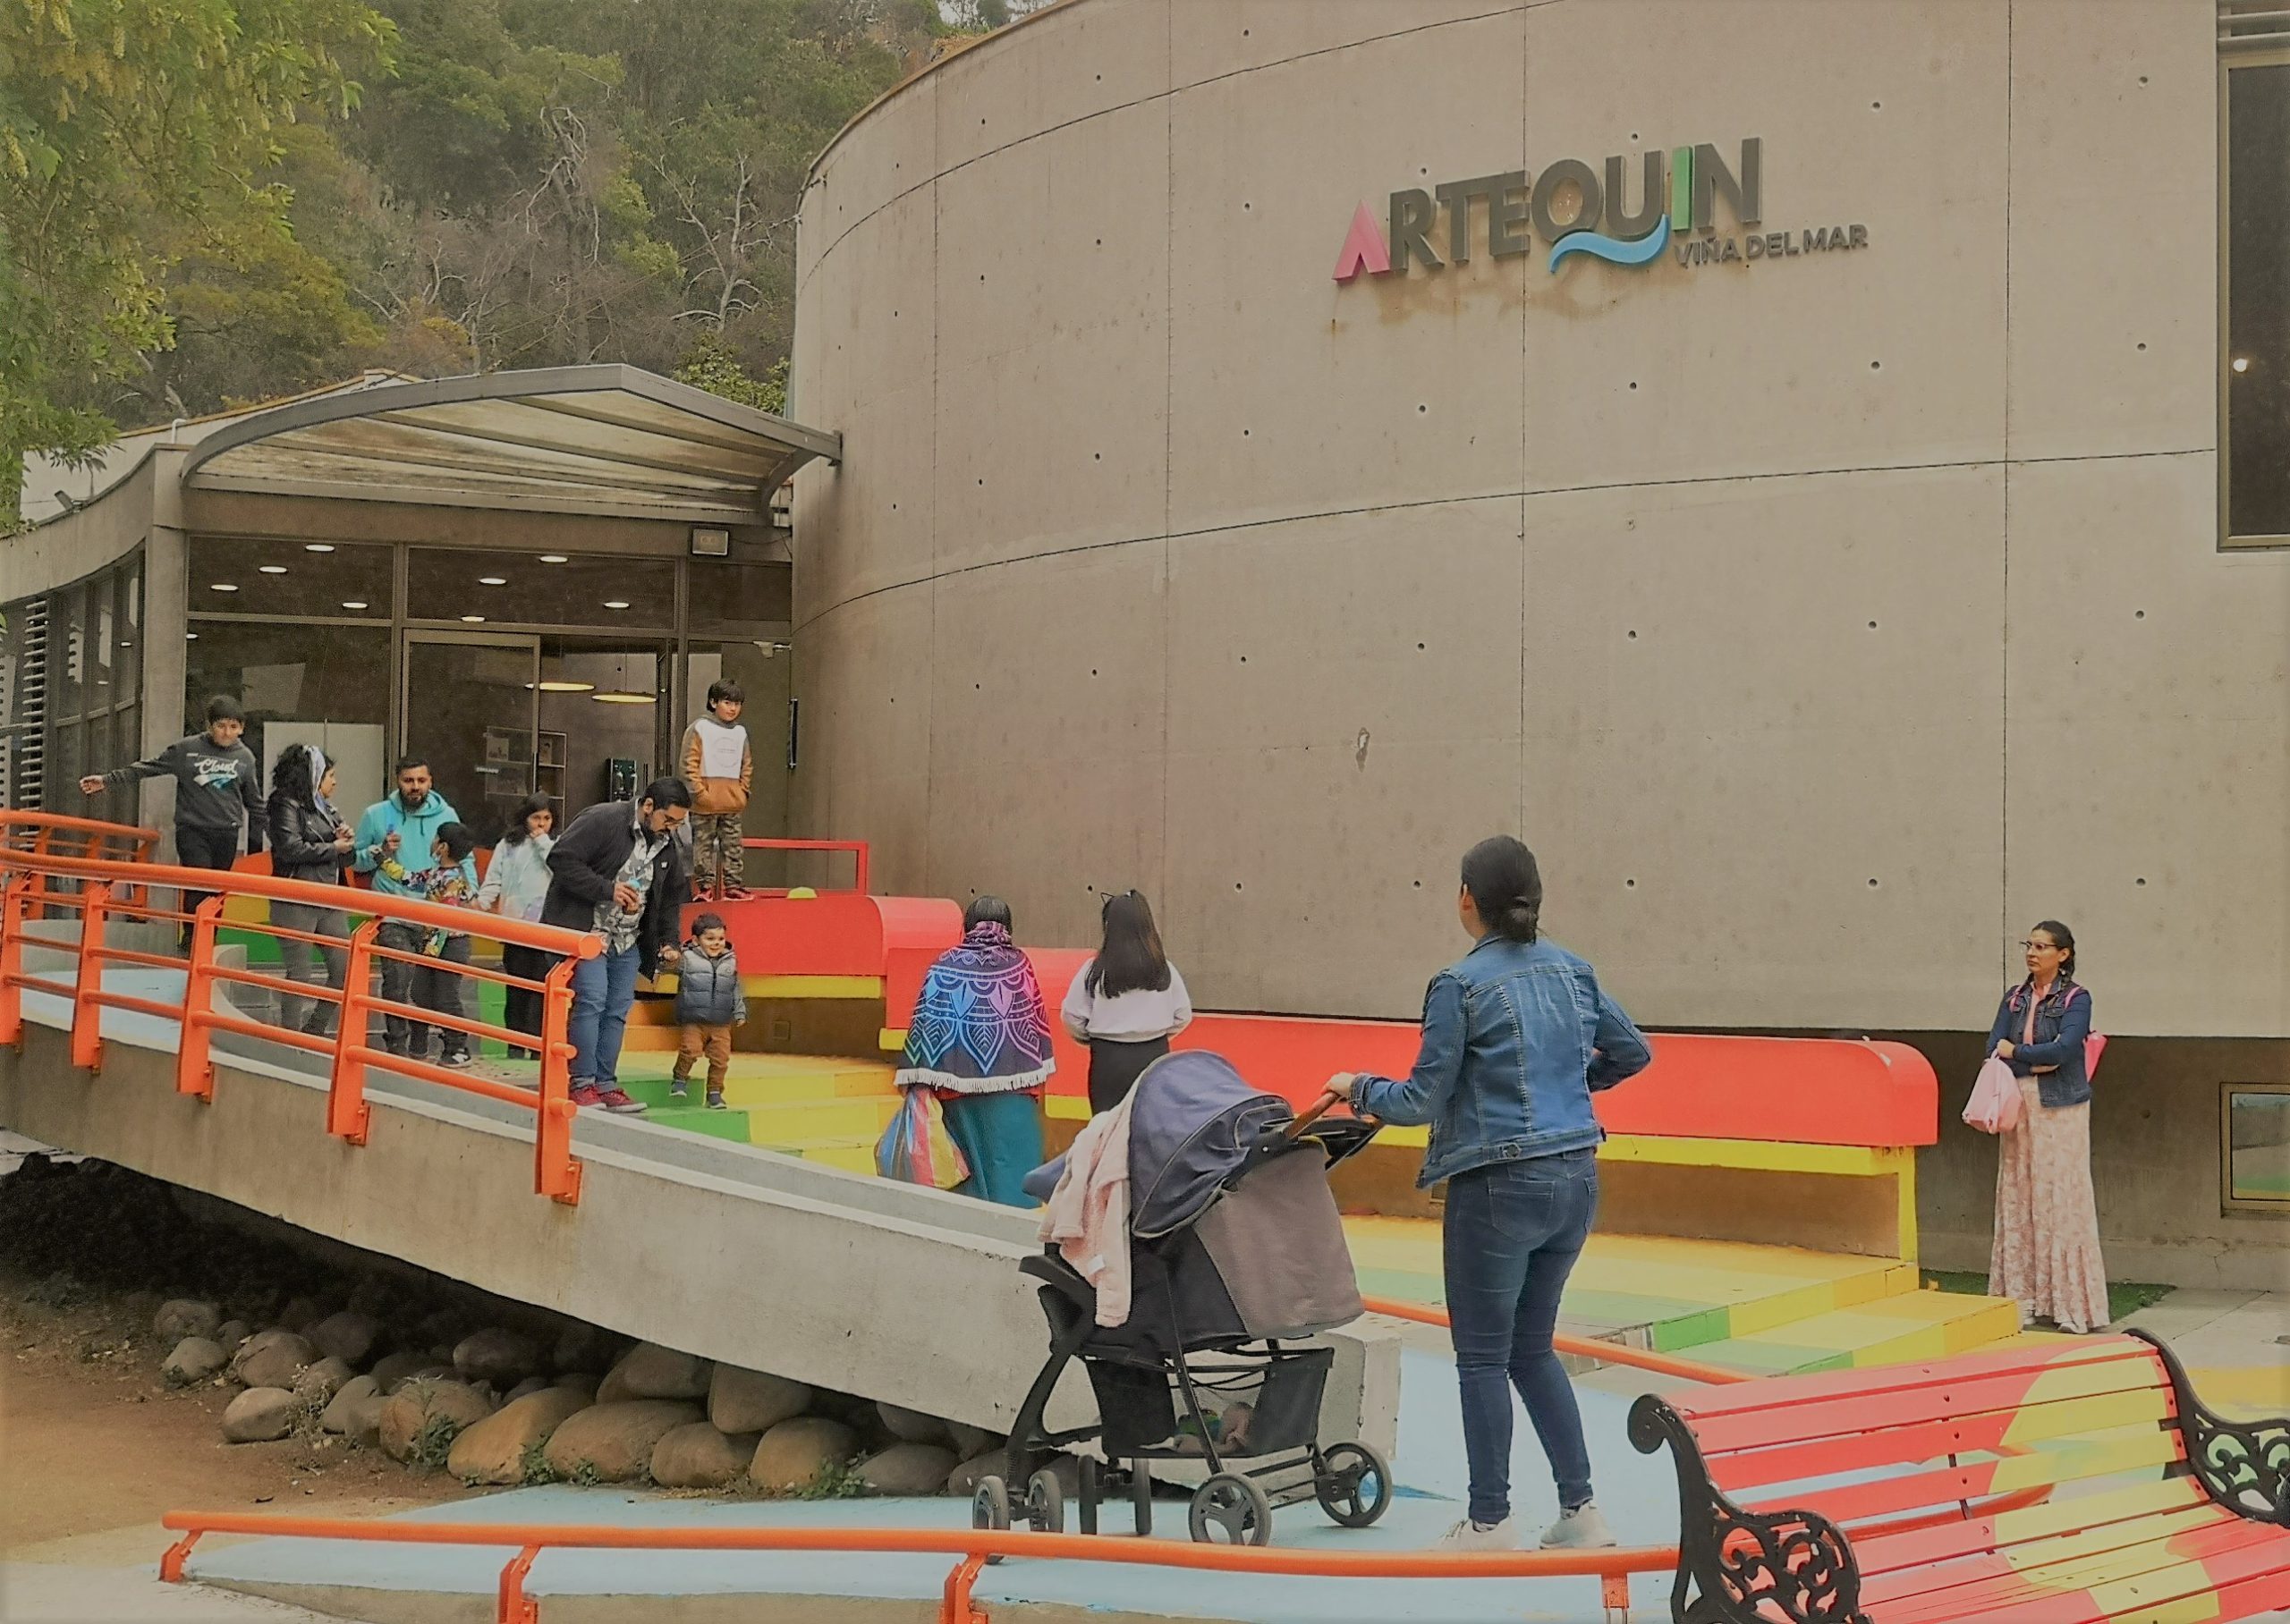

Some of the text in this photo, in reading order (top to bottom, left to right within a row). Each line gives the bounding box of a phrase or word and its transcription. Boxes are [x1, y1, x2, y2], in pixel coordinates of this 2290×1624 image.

[1332, 137, 1761, 280] ARTEQUIN
[1675, 224, 1869, 267] VIÑA DEL MAR
[194, 758, 239, 776] Cloud
